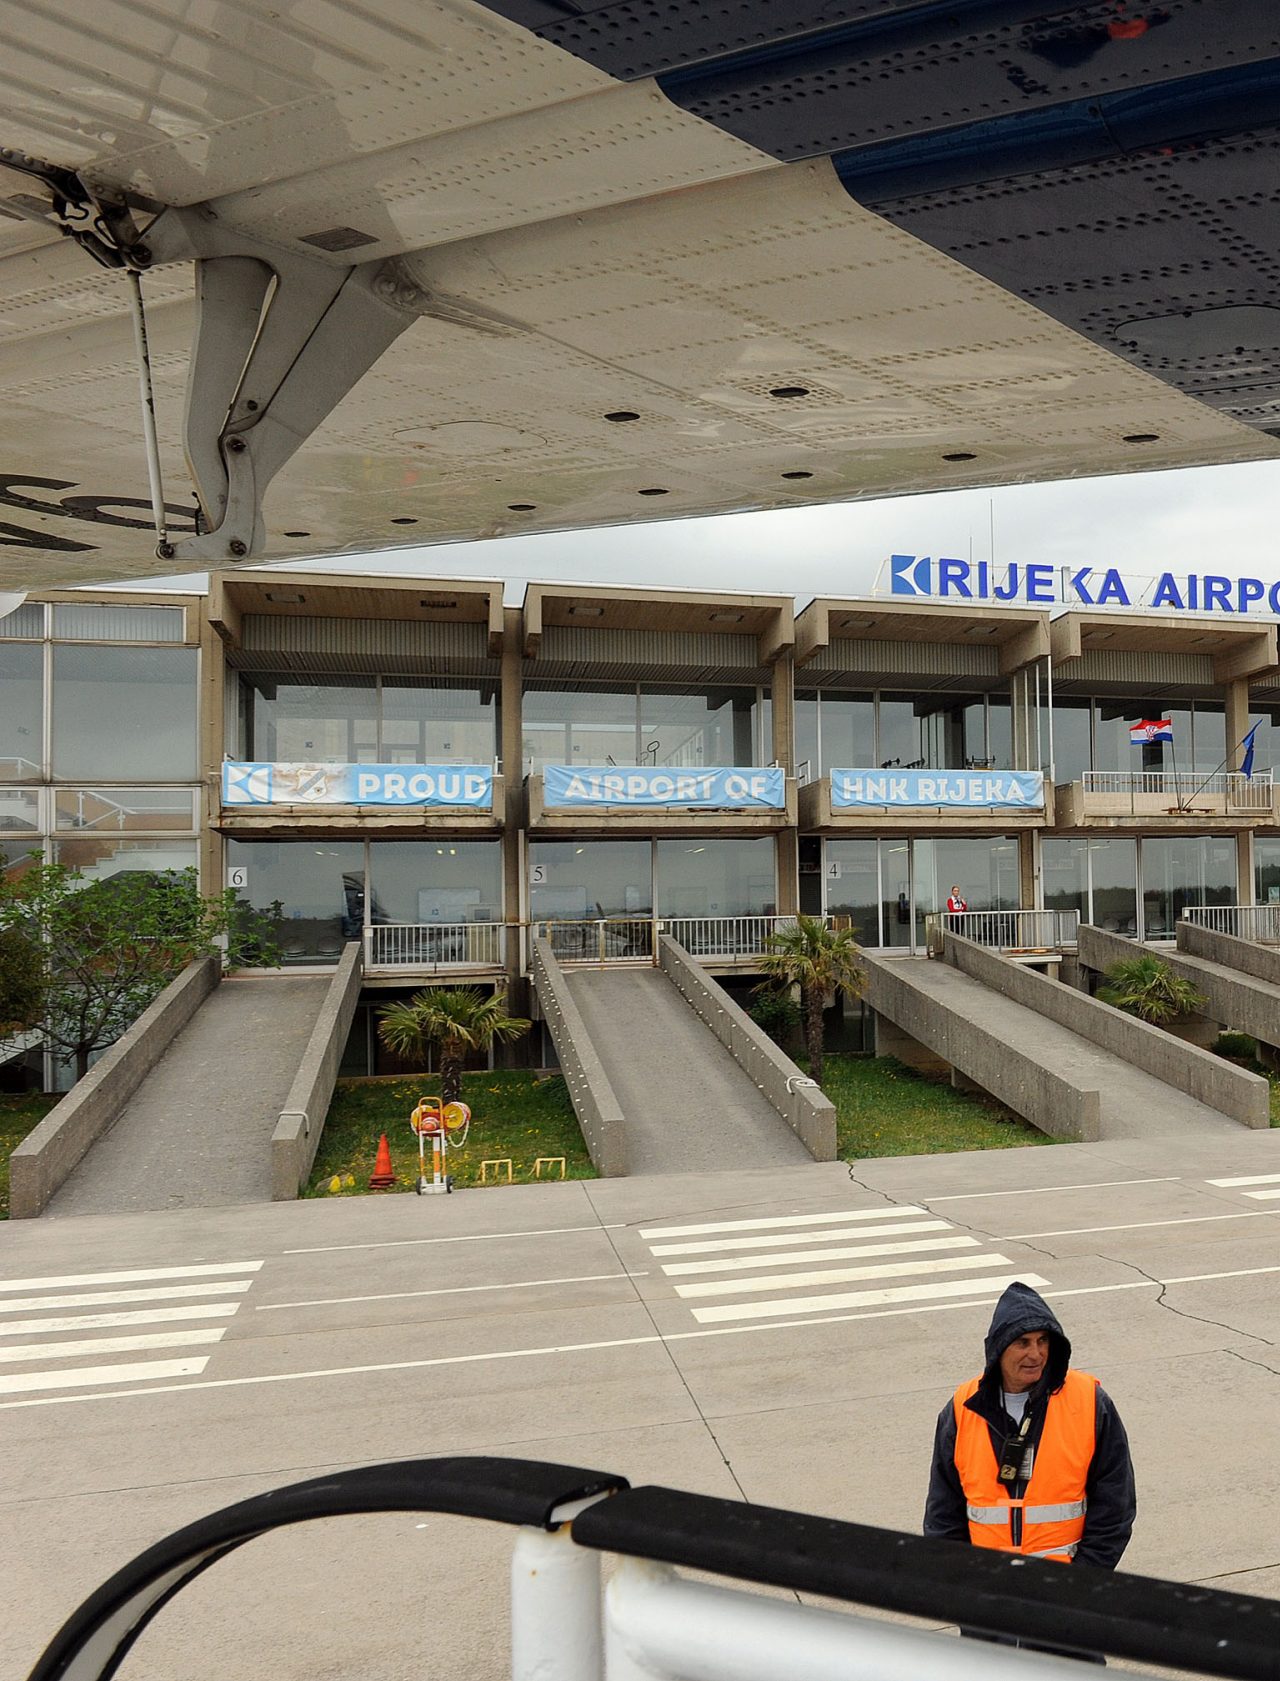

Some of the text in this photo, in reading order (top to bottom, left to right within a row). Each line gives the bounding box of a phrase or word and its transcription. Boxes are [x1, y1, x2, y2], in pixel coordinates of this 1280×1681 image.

[938, 558, 1130, 606] RIJEKA
[358, 773, 487, 800] PROUD
[564, 774, 767, 801] AIRPORT OF
[842, 776, 1025, 801] HNK RIJEKA
[232, 869, 243, 885] 6
[533, 865, 543, 881] 5
[829, 863, 838, 878] 4
